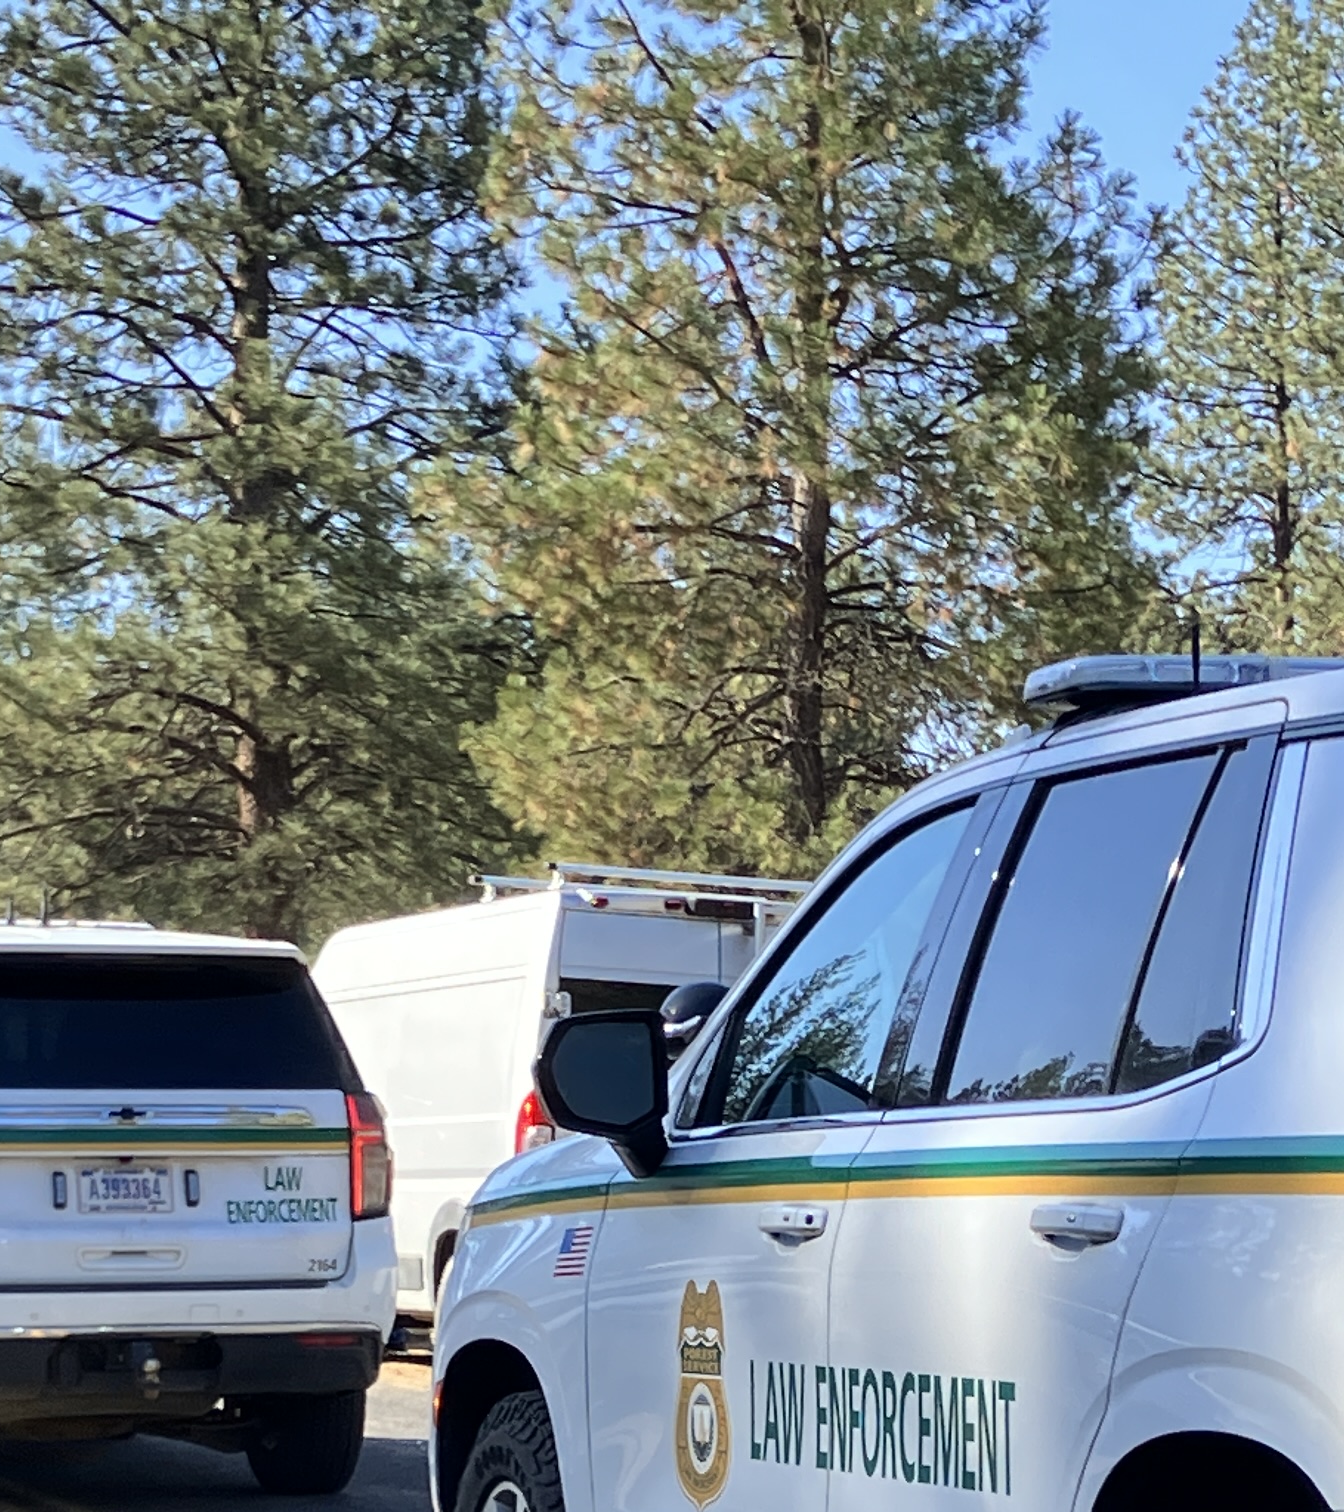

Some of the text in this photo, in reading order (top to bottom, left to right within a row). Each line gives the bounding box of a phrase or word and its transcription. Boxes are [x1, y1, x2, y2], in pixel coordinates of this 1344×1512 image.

[89, 1177, 162, 1200] A393364
[264, 1166, 303, 1191] LAW
[226, 1197, 338, 1224] ENFORCEMENT
[749, 1359, 1016, 1496] LAW ENFORCEMENT
